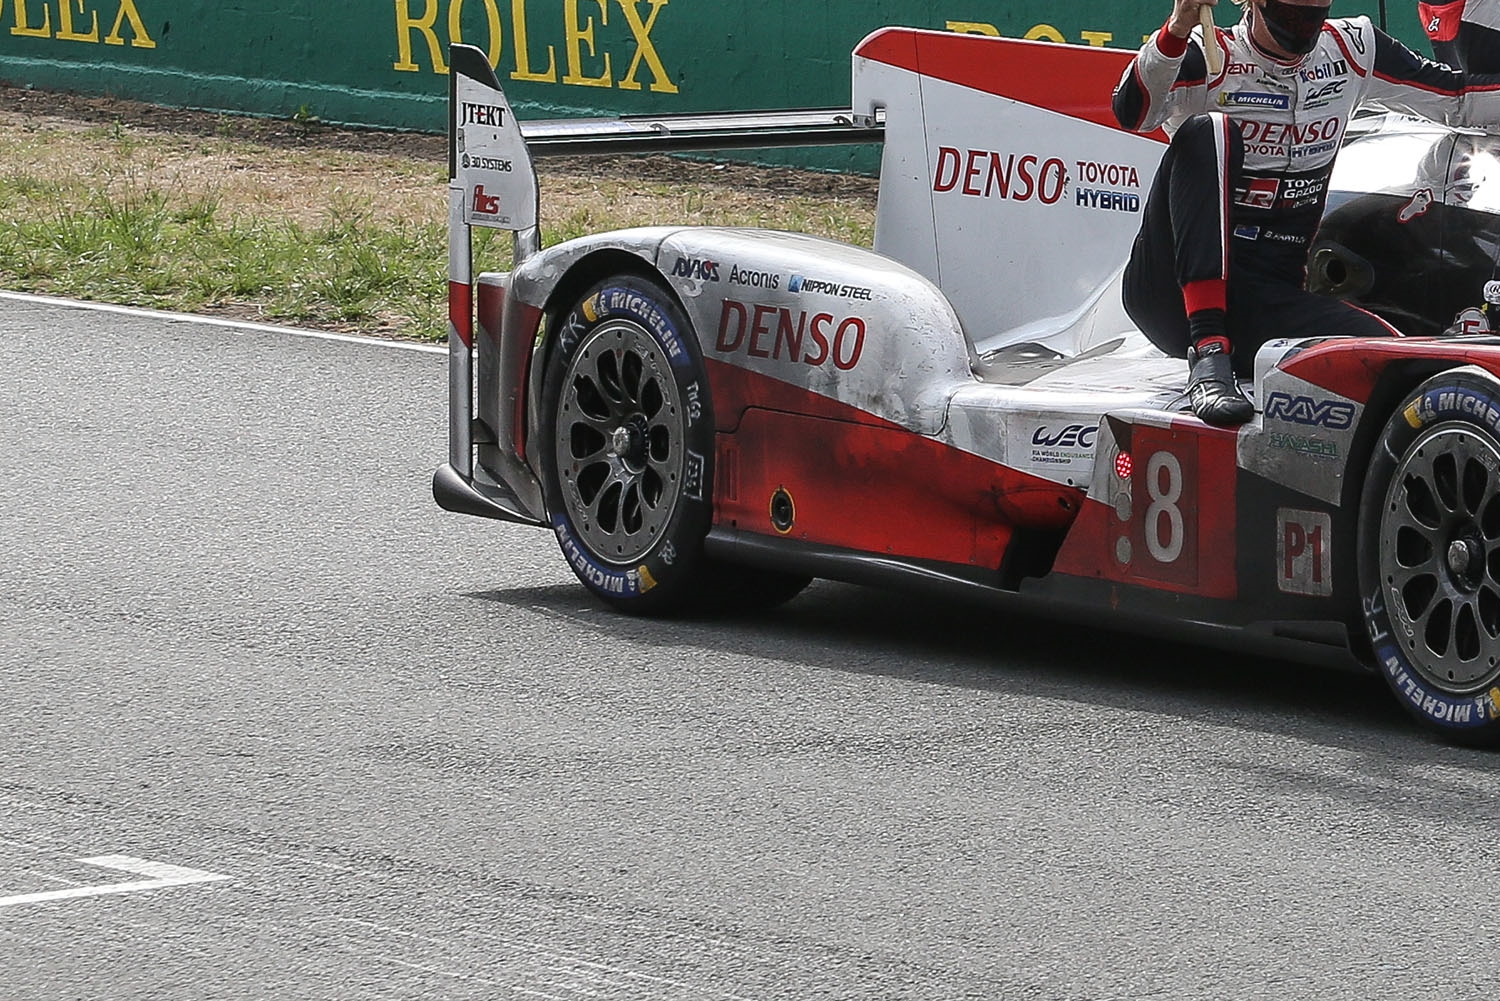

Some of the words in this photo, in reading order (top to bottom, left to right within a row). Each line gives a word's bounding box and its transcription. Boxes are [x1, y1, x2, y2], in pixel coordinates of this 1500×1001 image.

[461, 101, 506, 128] JTEKT
[1237, 96, 1284, 106] MICHELIN
[1240, 117, 1340, 145] DENSO
[1243, 144, 1285, 156] OYOTA
[481, 158, 512, 172] SYSTEMS
[933, 146, 1066, 205] DENSO
[1076, 160, 1140, 188] TOYOTA
[1075, 187, 1140, 213] HYBRID
[728, 263, 780, 290] Acronis
[801, 278, 840, 296] NIPPON
[839, 285, 873, 301] STEEL
[611, 291, 682, 358] MICHELIN
[715, 299, 867, 372] DENSO
[1266, 391, 1357, 431] RAYS
[1032, 424, 1100, 448] WEC
[1145, 451, 1184, 563] 8
[556, 523, 624, 594] MICHELIN
[1284, 522, 1322, 583] P1
[1384, 654, 1471, 723] MICHELIN
